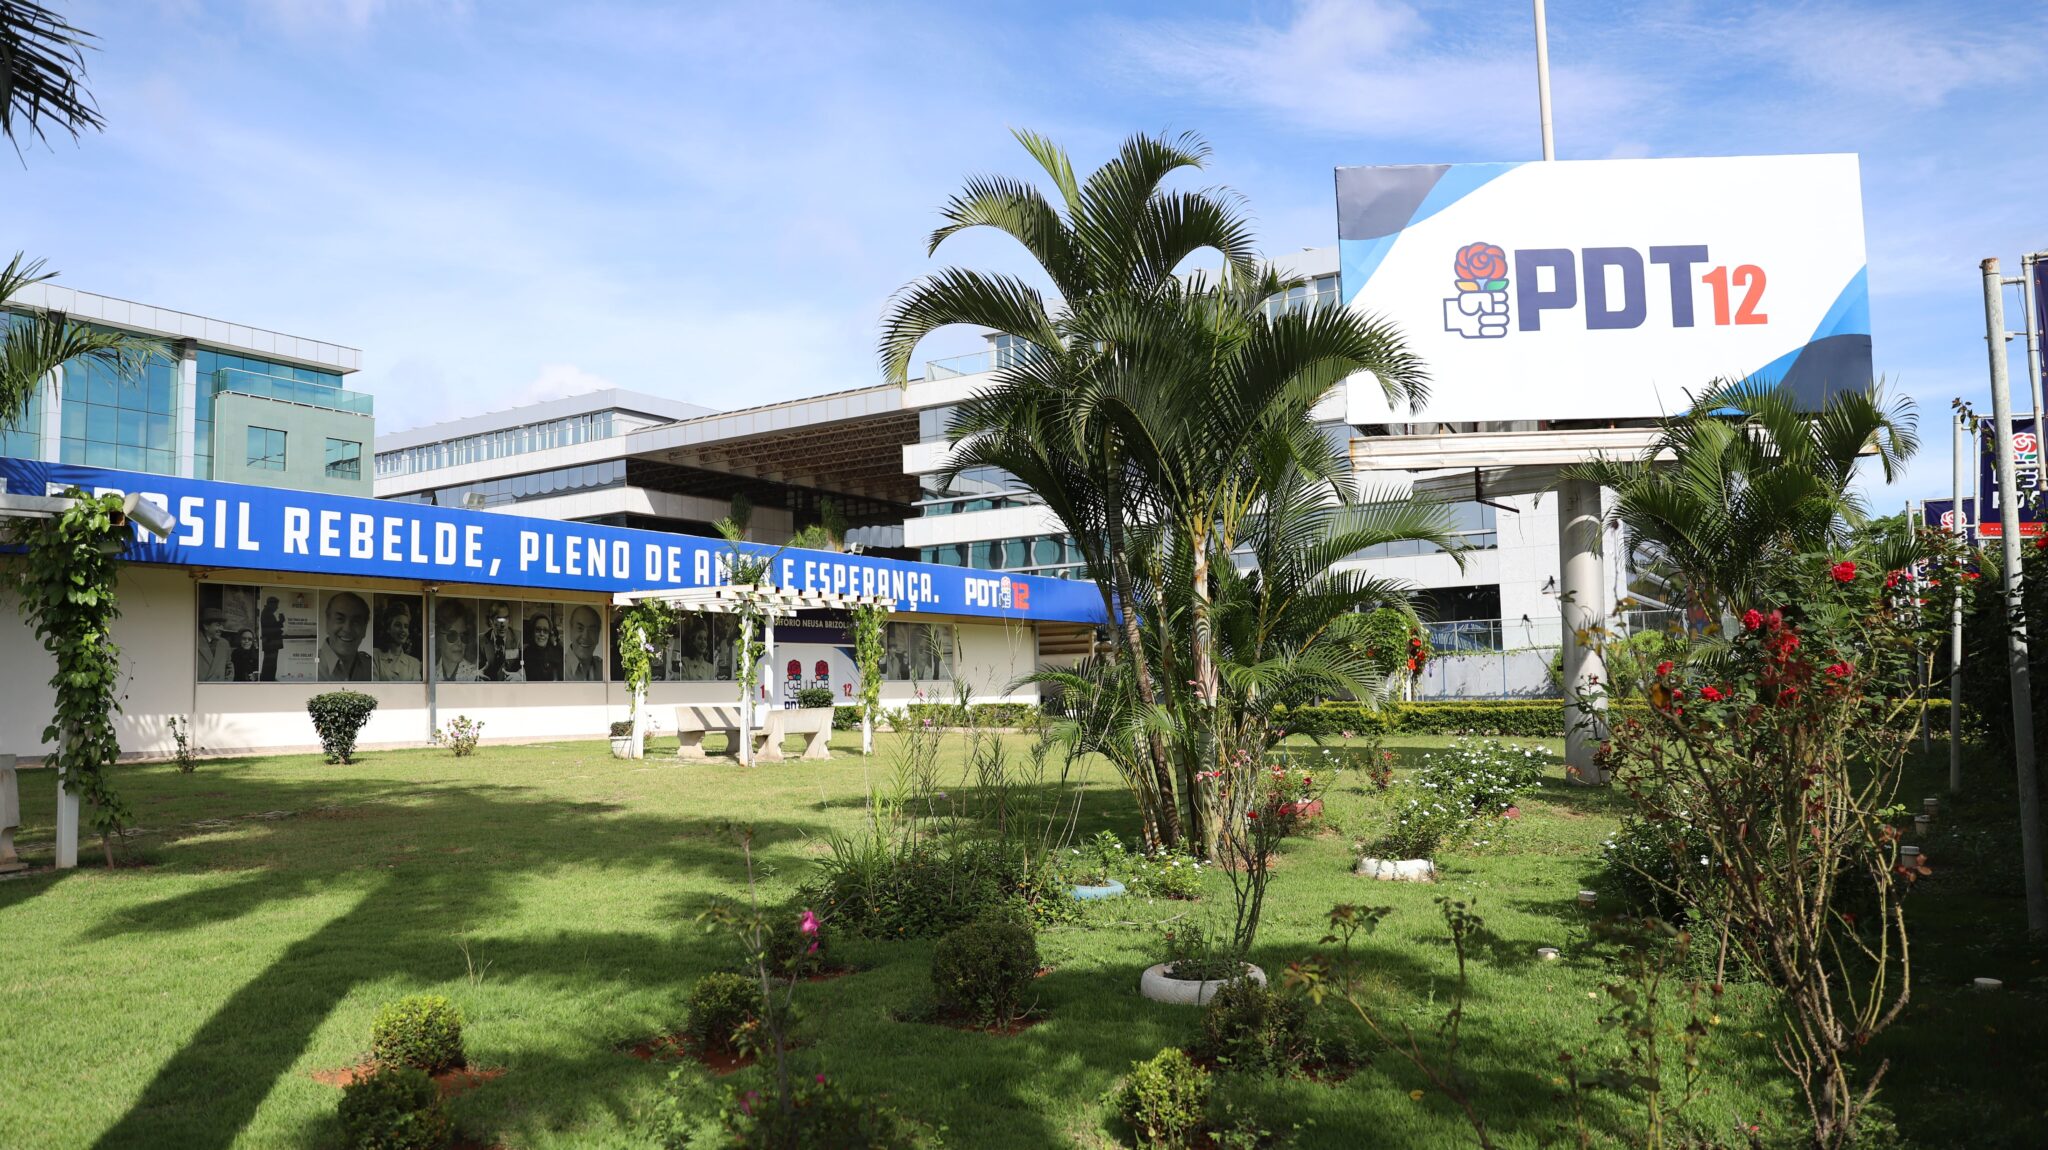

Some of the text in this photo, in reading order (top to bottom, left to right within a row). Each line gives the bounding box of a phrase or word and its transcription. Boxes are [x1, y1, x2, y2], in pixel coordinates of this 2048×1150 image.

[1514, 244, 1768, 332] PDT 12
[46, 482, 260, 551] ASIL
[283, 506, 501, 577] REBELDE,
[520, 530, 630, 579] PLENO
[645, 543, 682, 583] DE
[782, 558, 795, 590] E
[805, 560, 940, 612] ESPERANÇA.
[964, 577, 1030, 610] PDT 12
[802, 620, 823, 628] NEUSA
[824, 621, 849, 629] BRIZOL
[842, 683, 852, 697] 12
